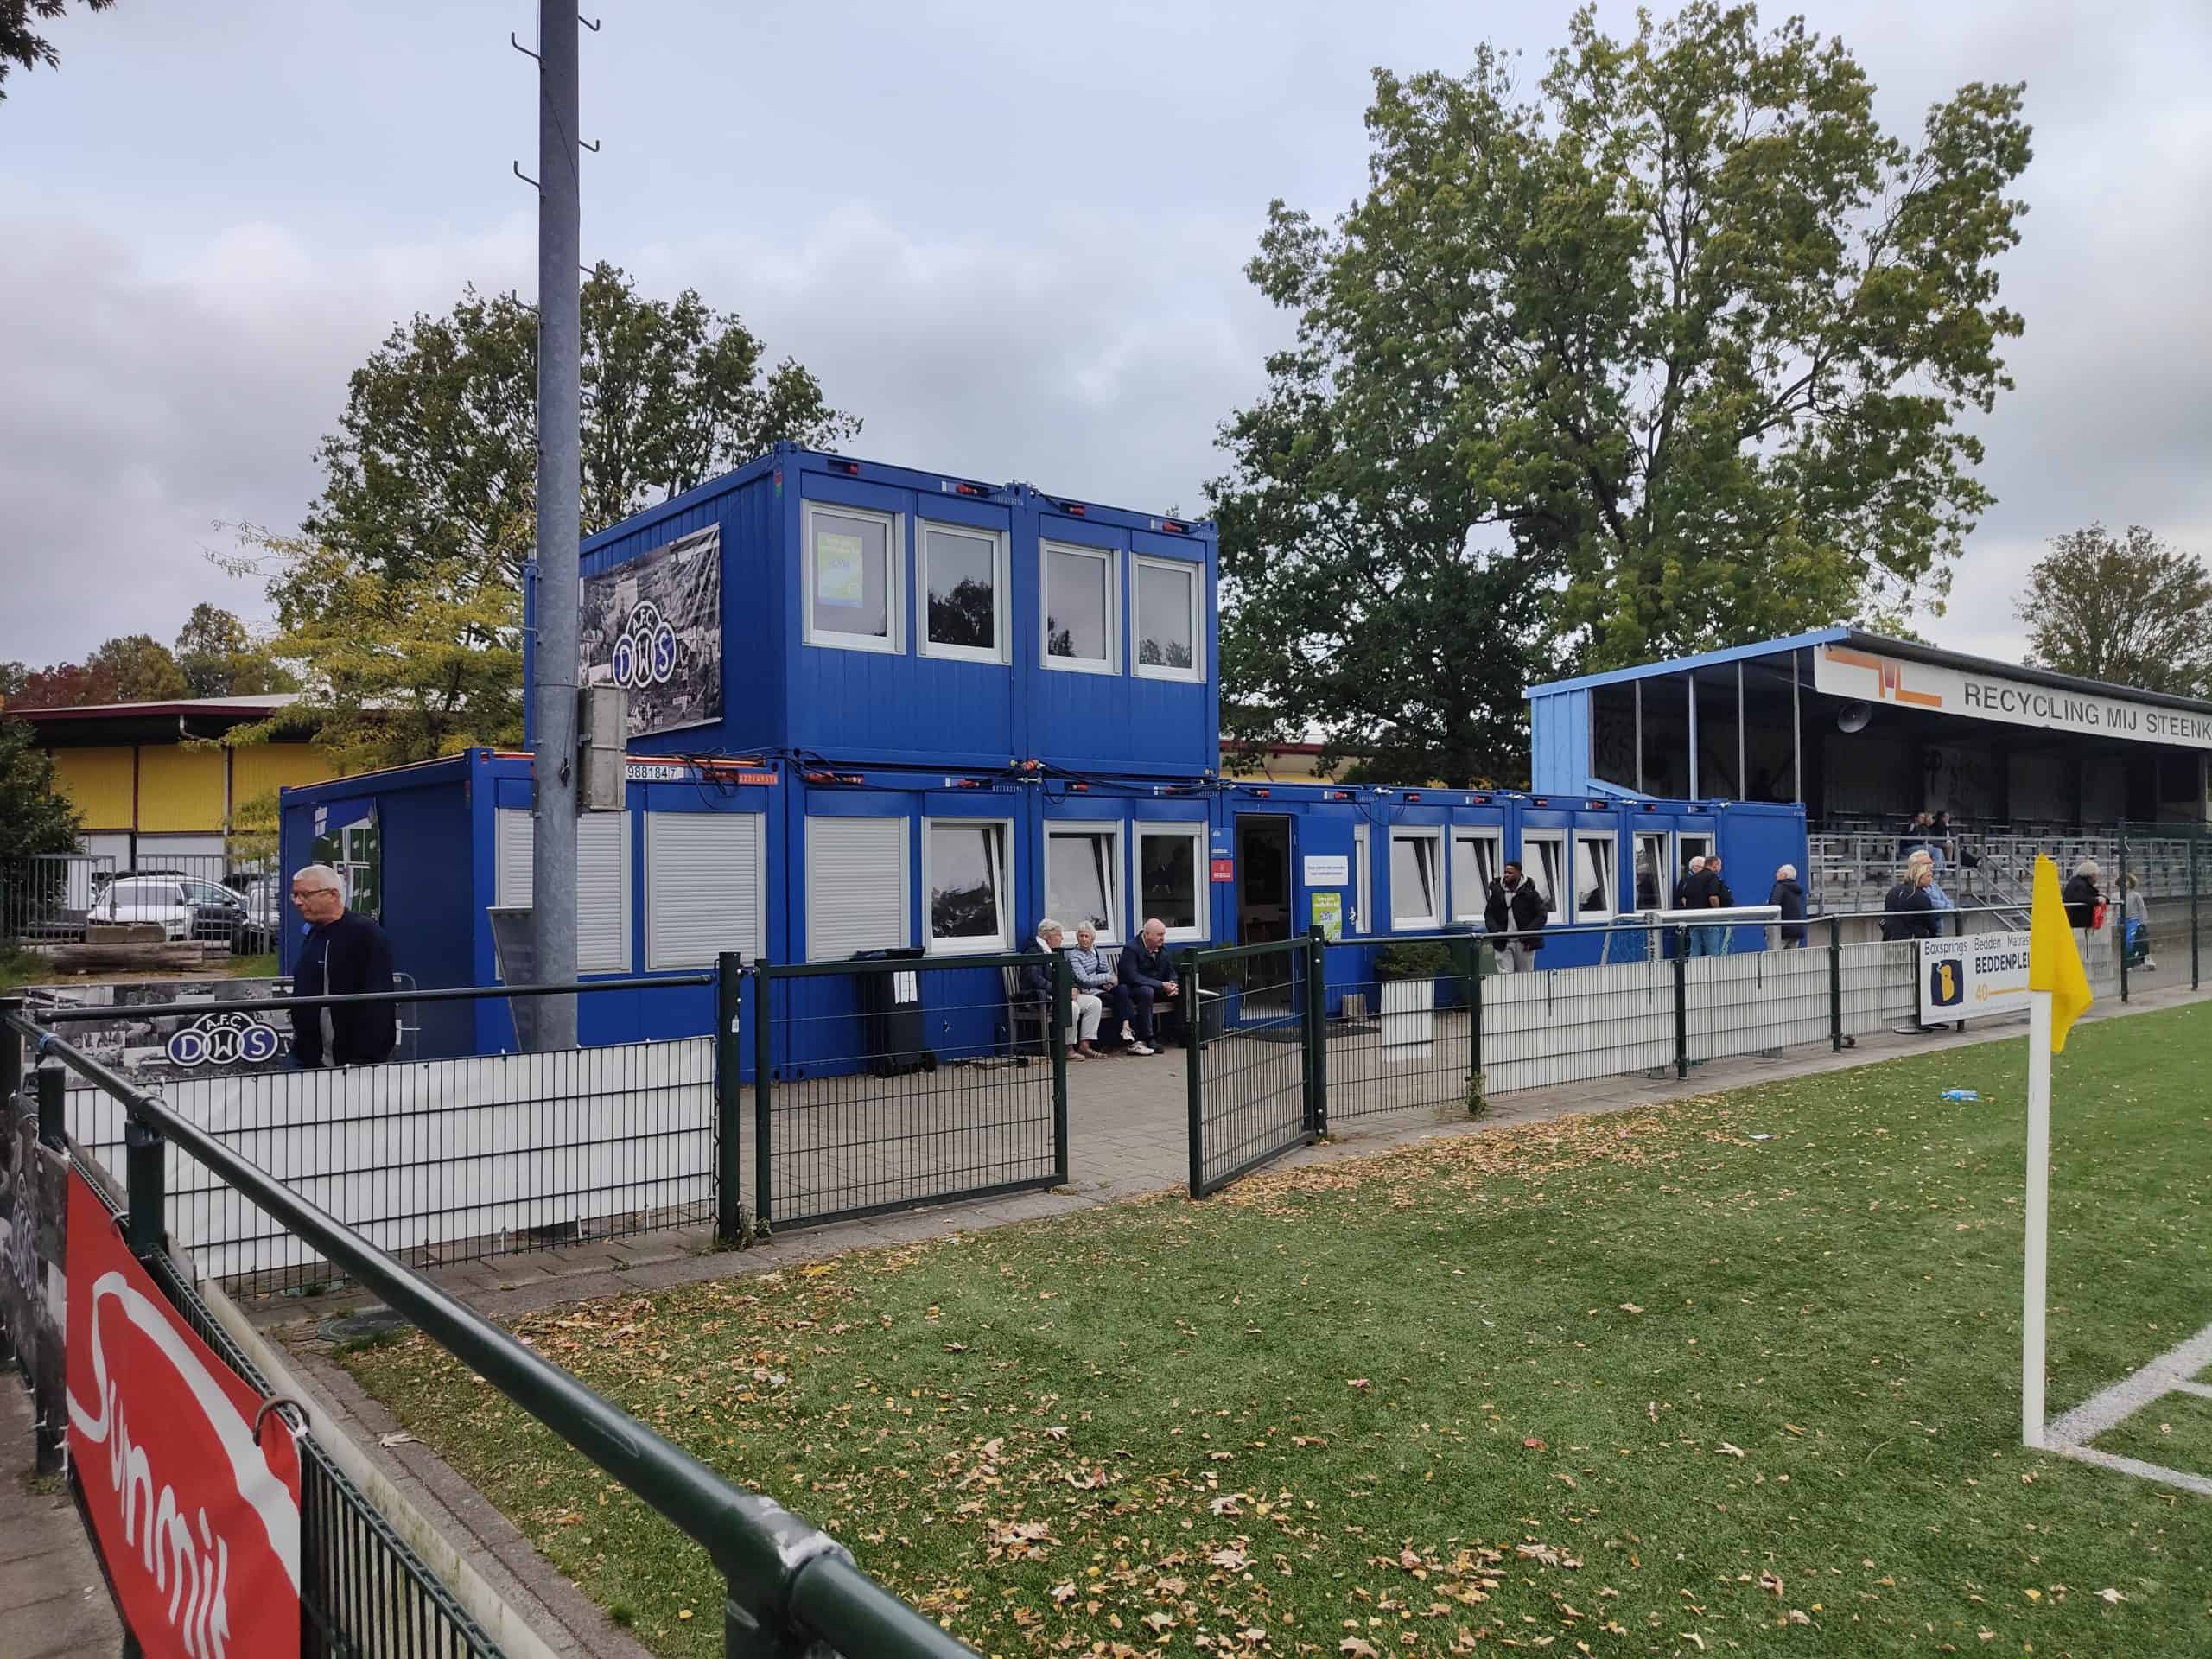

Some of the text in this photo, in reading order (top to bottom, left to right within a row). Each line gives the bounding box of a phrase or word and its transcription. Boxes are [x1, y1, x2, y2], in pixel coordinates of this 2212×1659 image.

[619, 631, 670, 683] DWS
[1964, 682, 2212, 741] RECYCLING MIJ STEENK
[1924, 940, 1967, 957] Boxsprings
[1974, 936, 2001, 951] Bedden
[206, 1014, 243, 1031] A.F.C.
[180, 1030, 266, 1061] DWS
